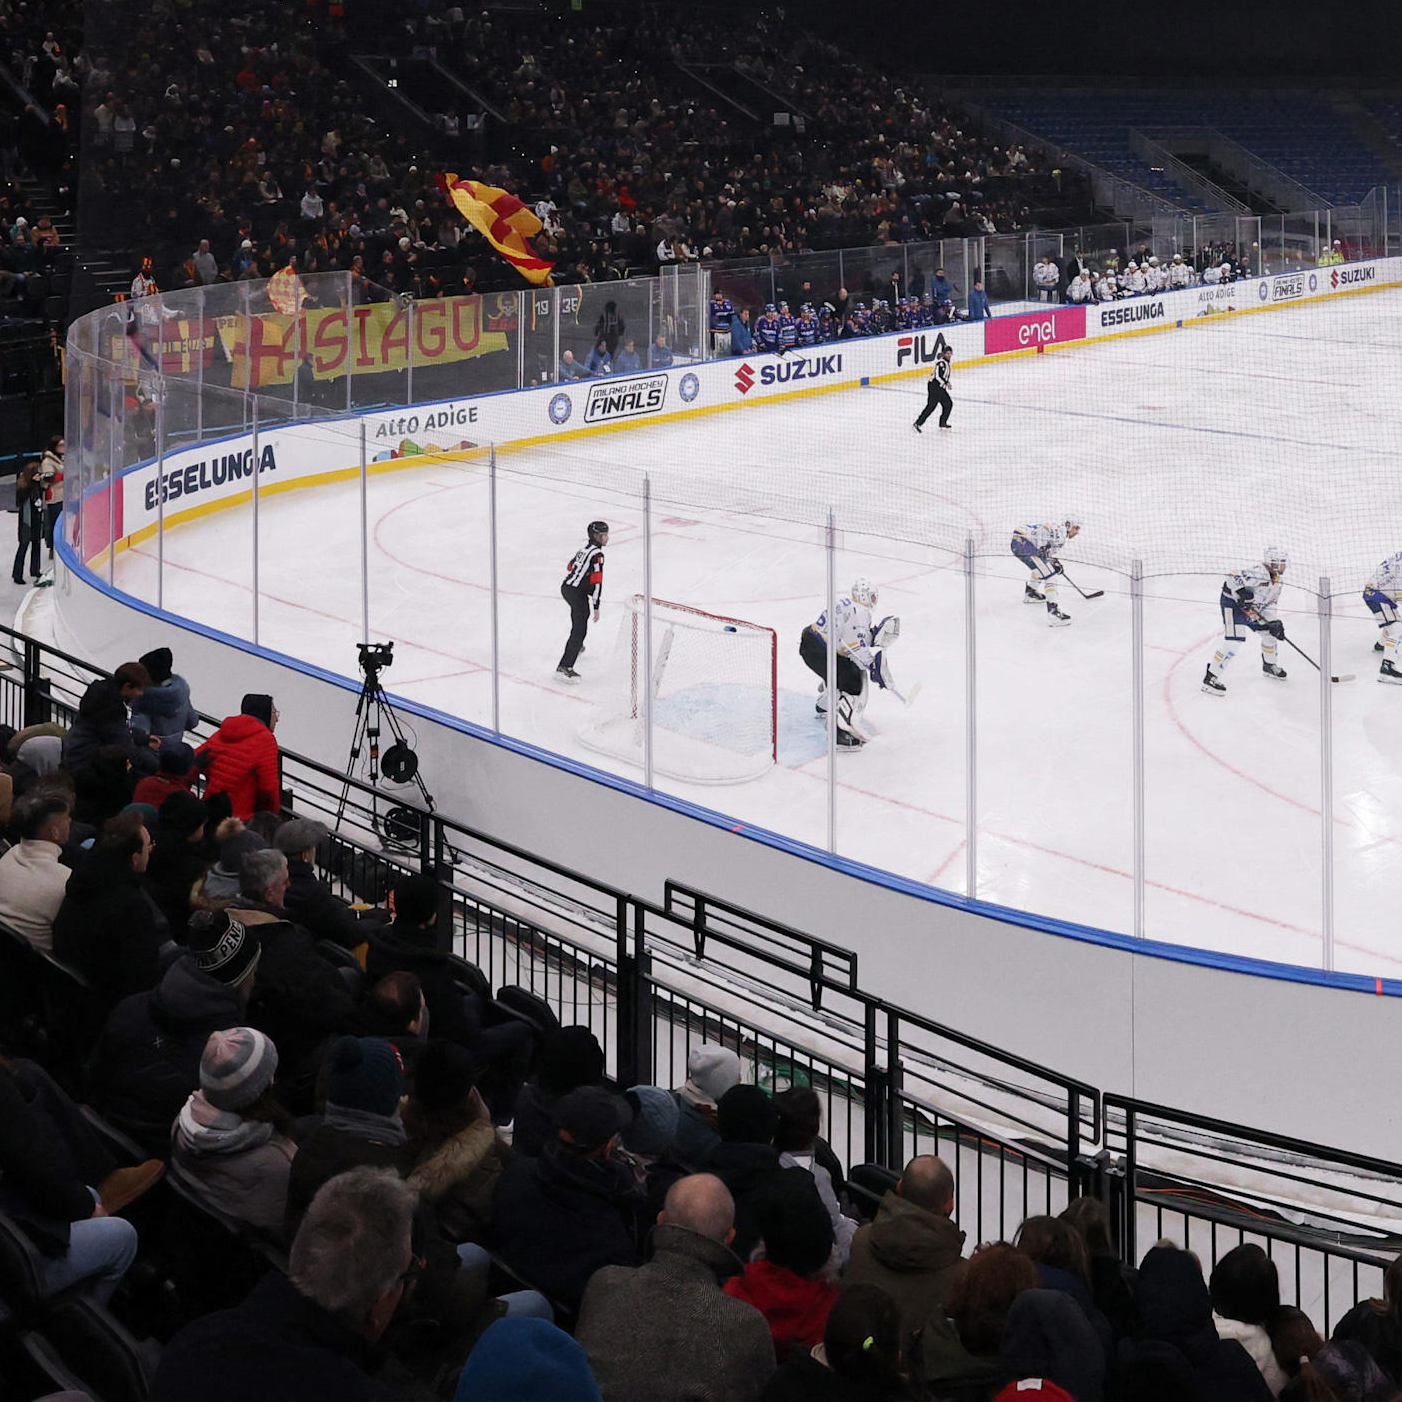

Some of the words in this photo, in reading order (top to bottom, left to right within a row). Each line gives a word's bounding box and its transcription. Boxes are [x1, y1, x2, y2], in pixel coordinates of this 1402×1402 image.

[1341, 267, 1375, 284] SUZUKI
[1274, 282, 1303, 298] FINALS
[1101, 301, 1164, 327] ESSELUNGA
[1019, 315, 1056, 345] enel
[897, 332, 947, 367] FILA
[760, 354, 842, 385] SUZUKI
[590, 389, 662, 417] FINALS
[593, 385, 627, 398] MILANO
[628, 380, 663, 393] HOCKEY
[145, 444, 276, 511] ESSELUNGA
